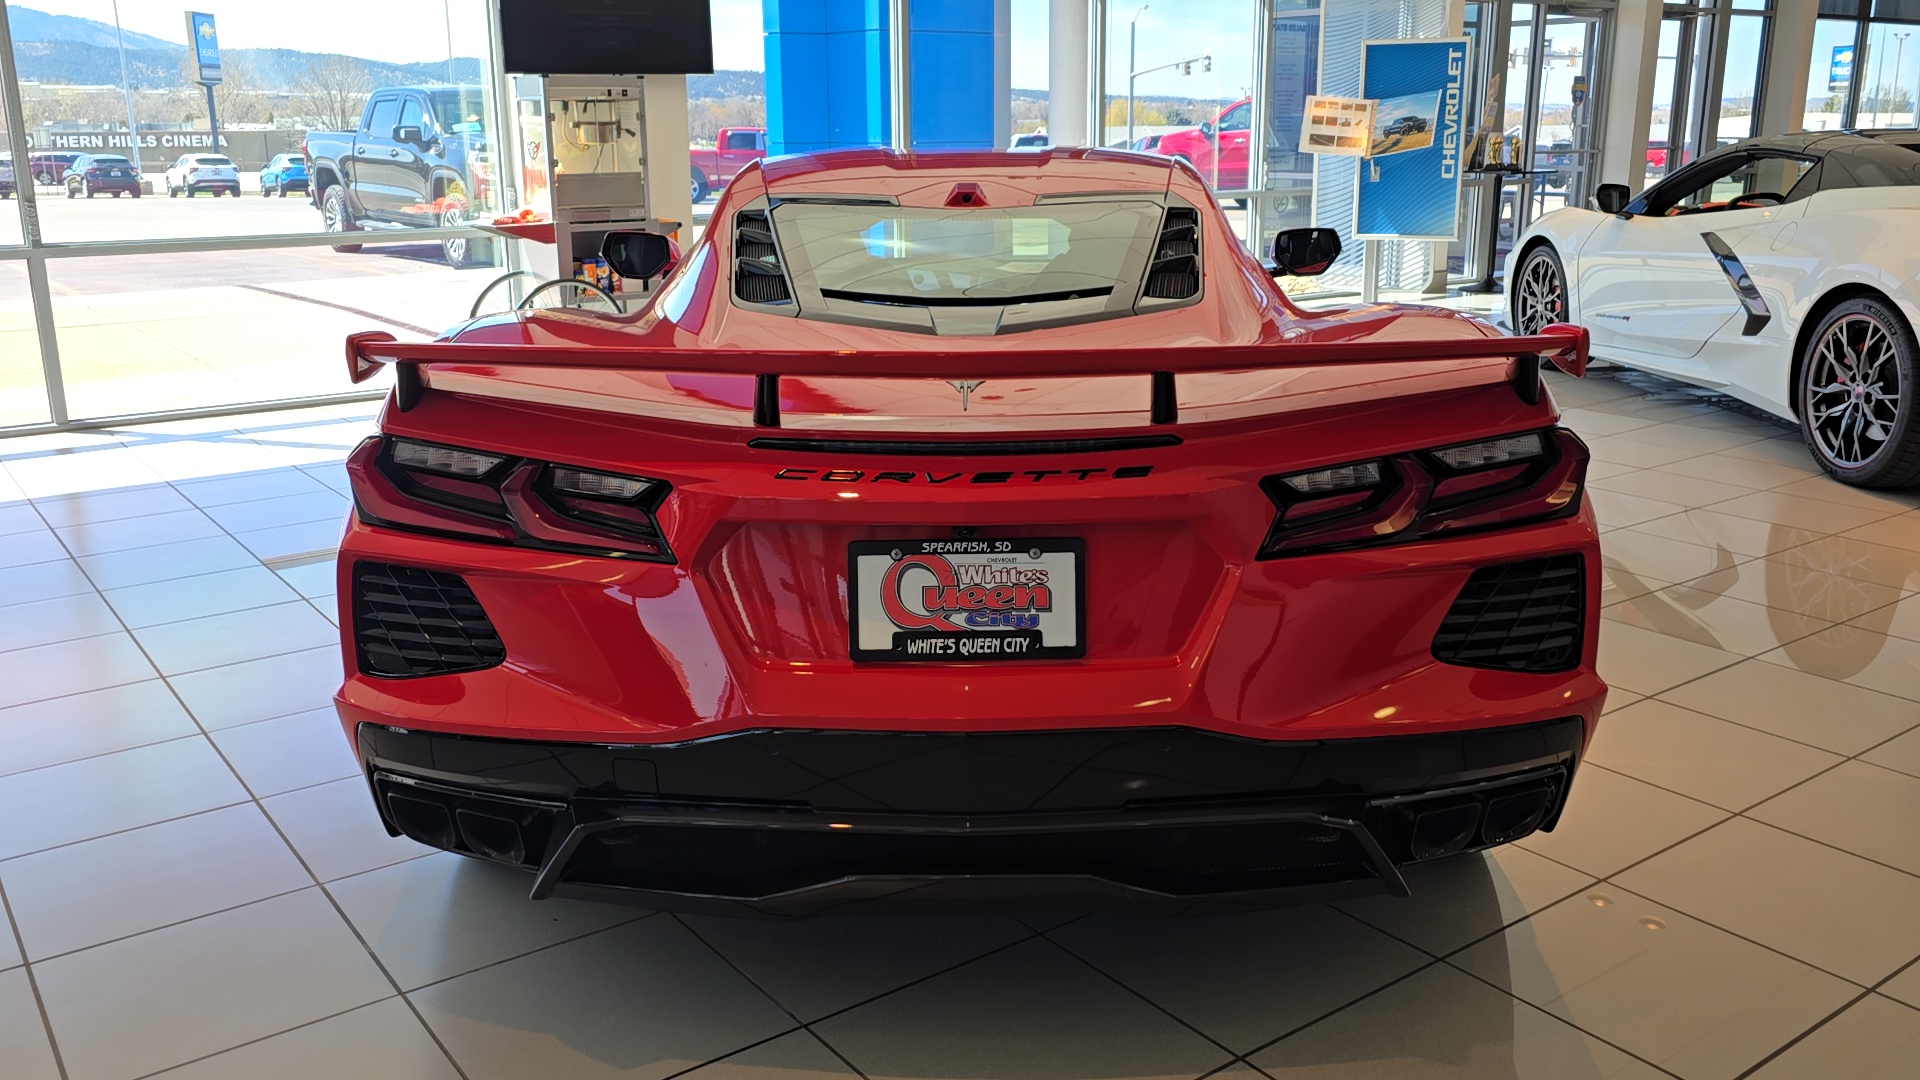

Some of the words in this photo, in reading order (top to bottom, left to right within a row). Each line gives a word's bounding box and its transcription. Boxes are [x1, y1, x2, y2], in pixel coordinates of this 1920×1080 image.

[1441, 47, 1463, 179] CHEVROLET
[26, 135, 104, 148] OTHERN
[108, 134, 157, 148] HILLS
[161, 134, 229, 148] CINEMA
[1869, 306, 1897, 334] MICHELIN
[773, 464, 1155, 484] CORVETTE
[921, 541, 990, 553] SPEARFISH,
[994, 541, 1012, 552] SD
[956, 564, 1049, 585] White's
[881, 554, 1053, 631] Queen
[964, 611, 1040, 629] City
[907, 637, 956, 655] WHITE'S
[959, 637, 1001, 656] QUEEN
[1003, 637, 1030, 654] CITY
